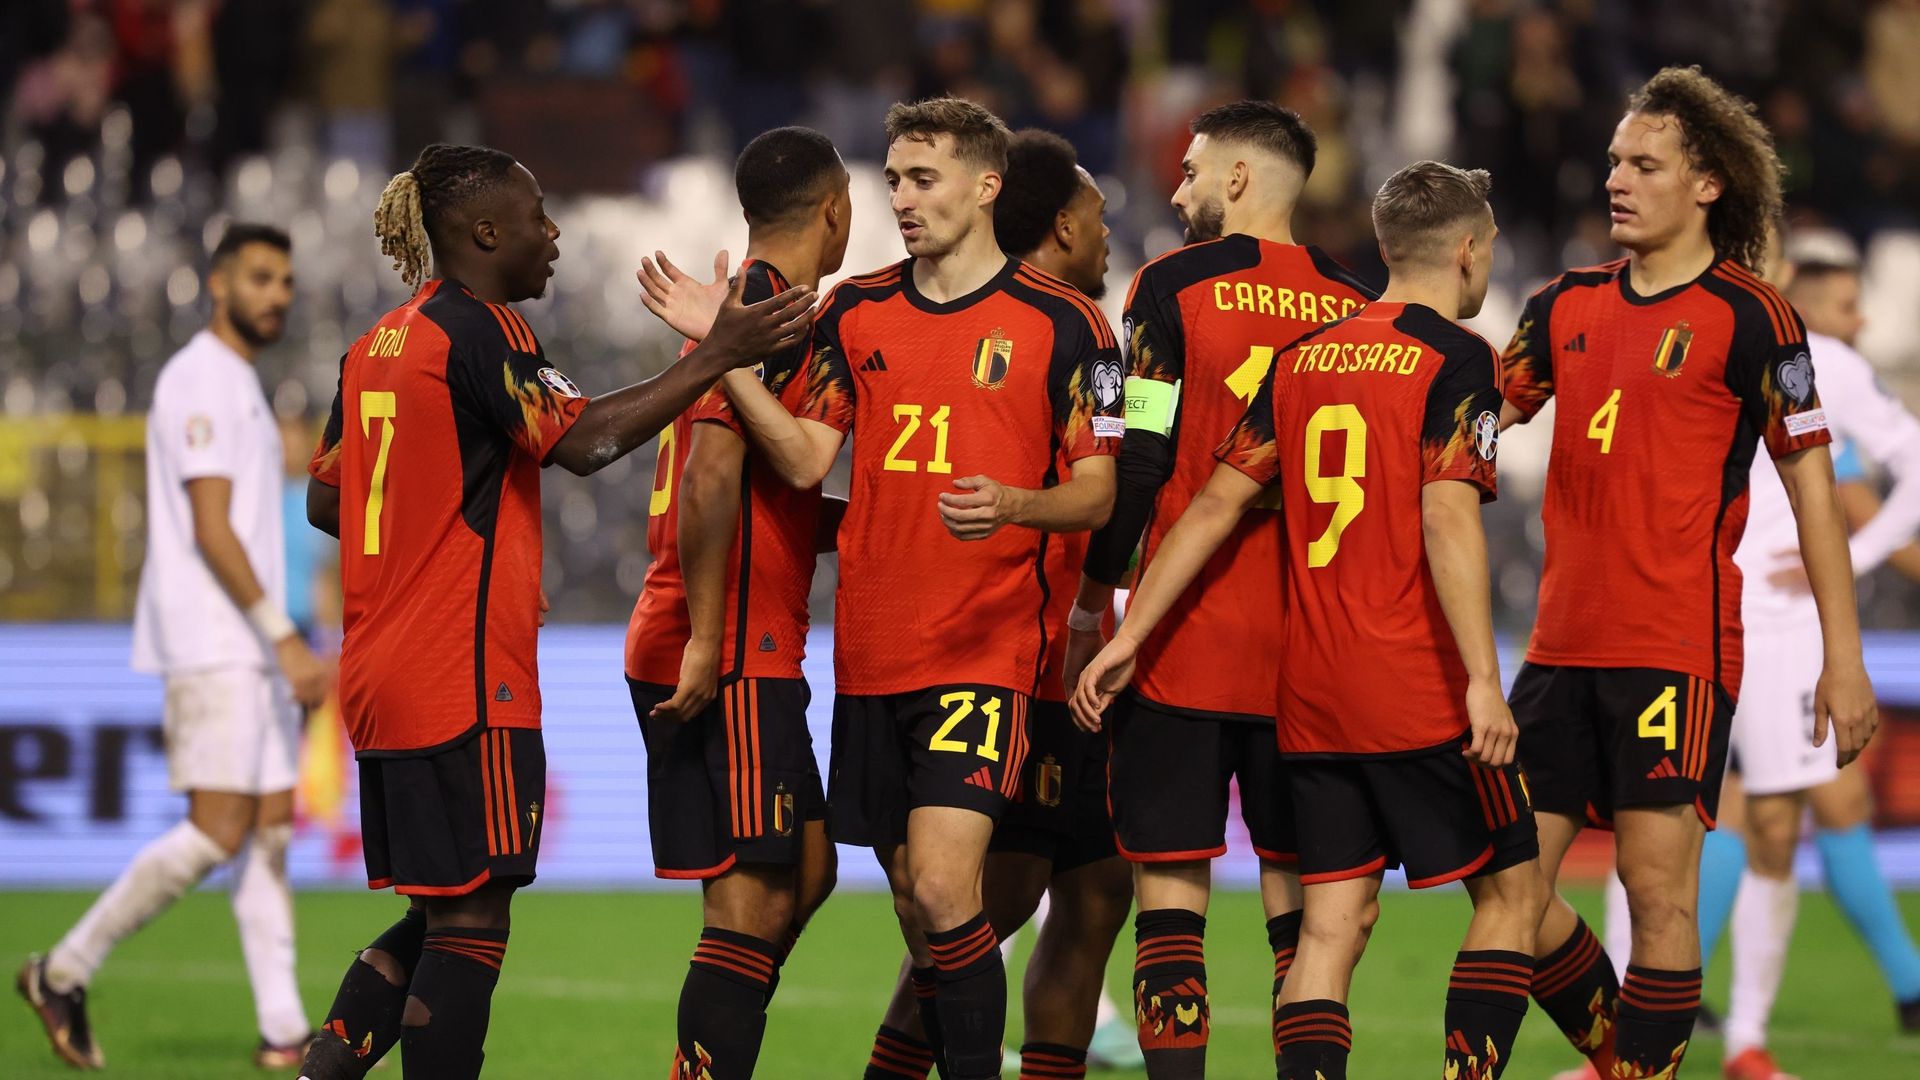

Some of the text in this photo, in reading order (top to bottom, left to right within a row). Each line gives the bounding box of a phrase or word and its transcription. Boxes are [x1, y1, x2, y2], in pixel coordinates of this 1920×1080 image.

[1214, 281, 1367, 323] CARRASC
[1293, 343, 1423, 375] TROSSARD
[883, 404, 952, 474] 21
[1586, 389, 1621, 454] 4
[360, 391, 397, 556] 7
[1304, 403, 1367, 568] 9
[929, 691, 1001, 761] 21
[1637, 686, 1677, 751] 4
